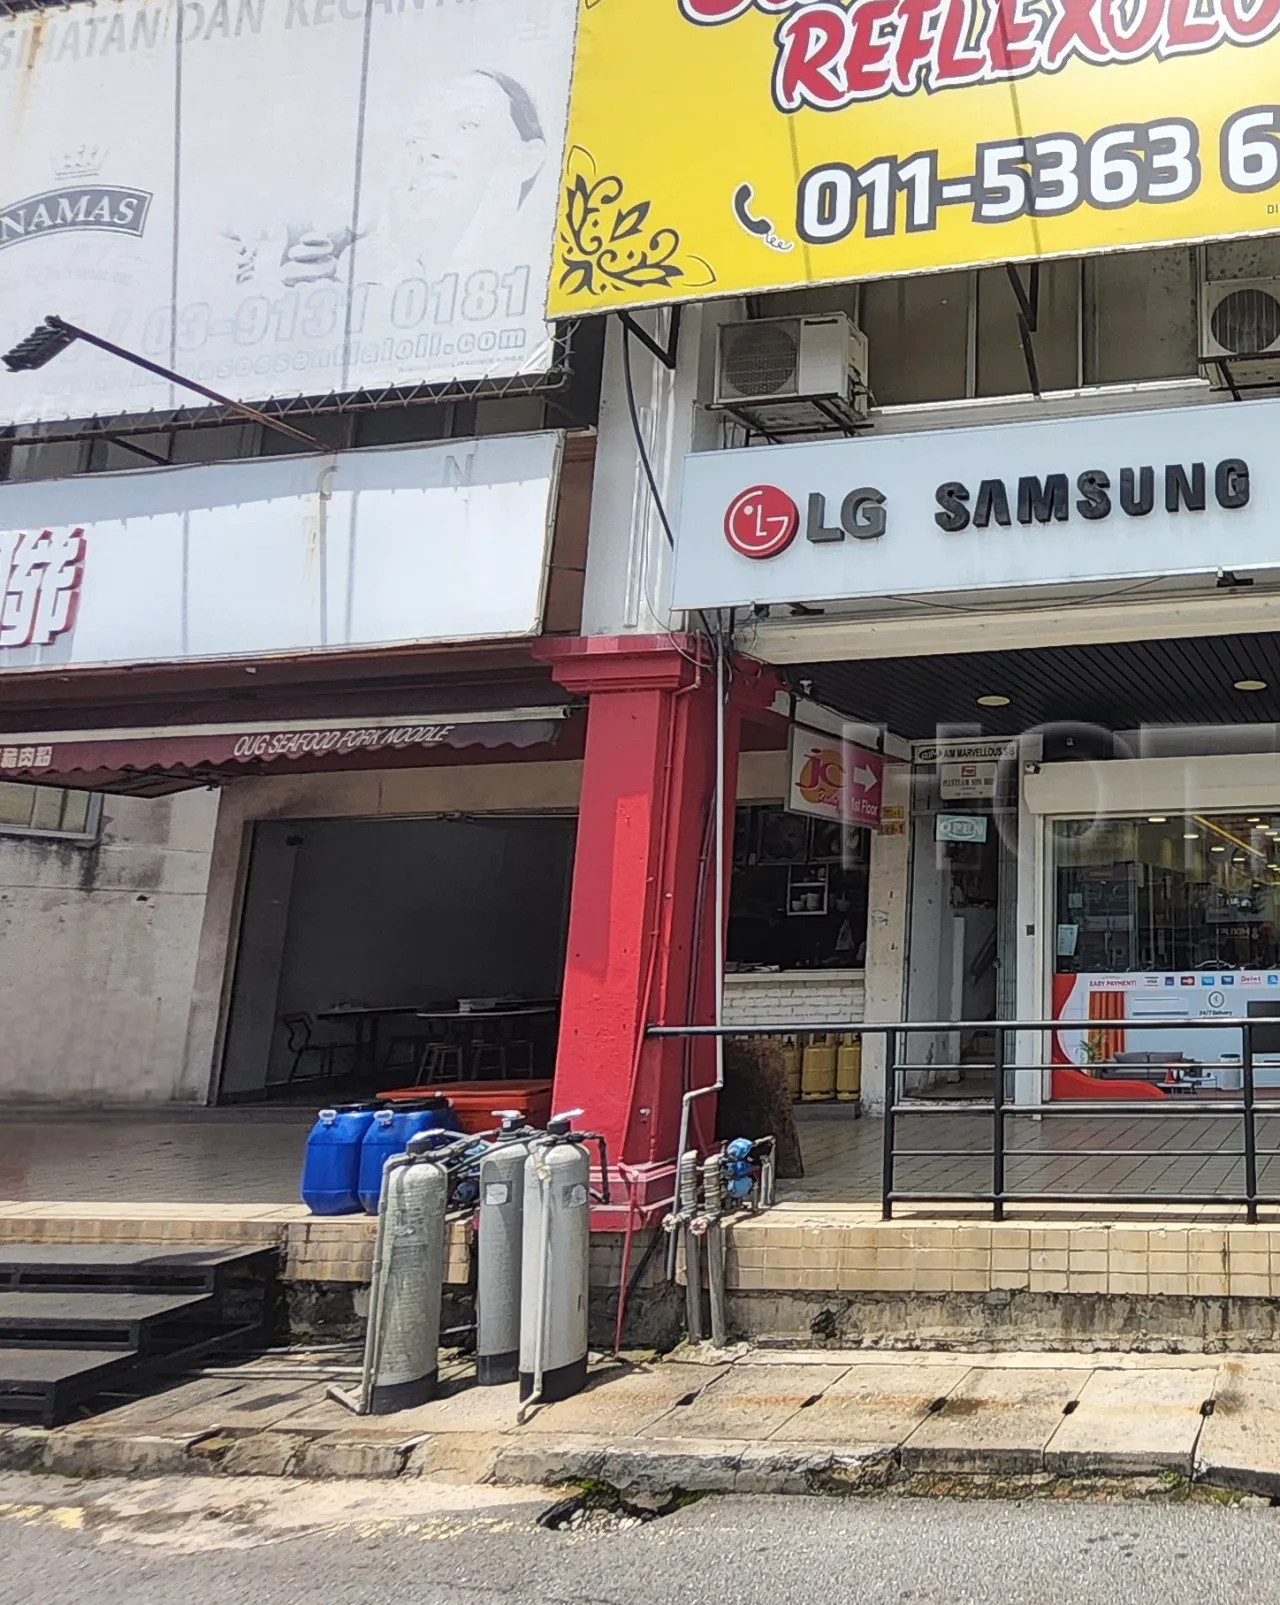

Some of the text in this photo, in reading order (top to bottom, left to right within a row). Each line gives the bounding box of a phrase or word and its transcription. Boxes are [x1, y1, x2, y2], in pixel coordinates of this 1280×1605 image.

[799, 118, 1199, 244] 011-5363
[0, 195, 138, 241] NAMAS
[390, 264, 530, 331] 0181
[806, 458, 1251, 544] LG SAMSUNG
[234, 725, 456, 757] OUG SEAFOOD PORK NOODLE
[861, 799, 878, 816] Floor
